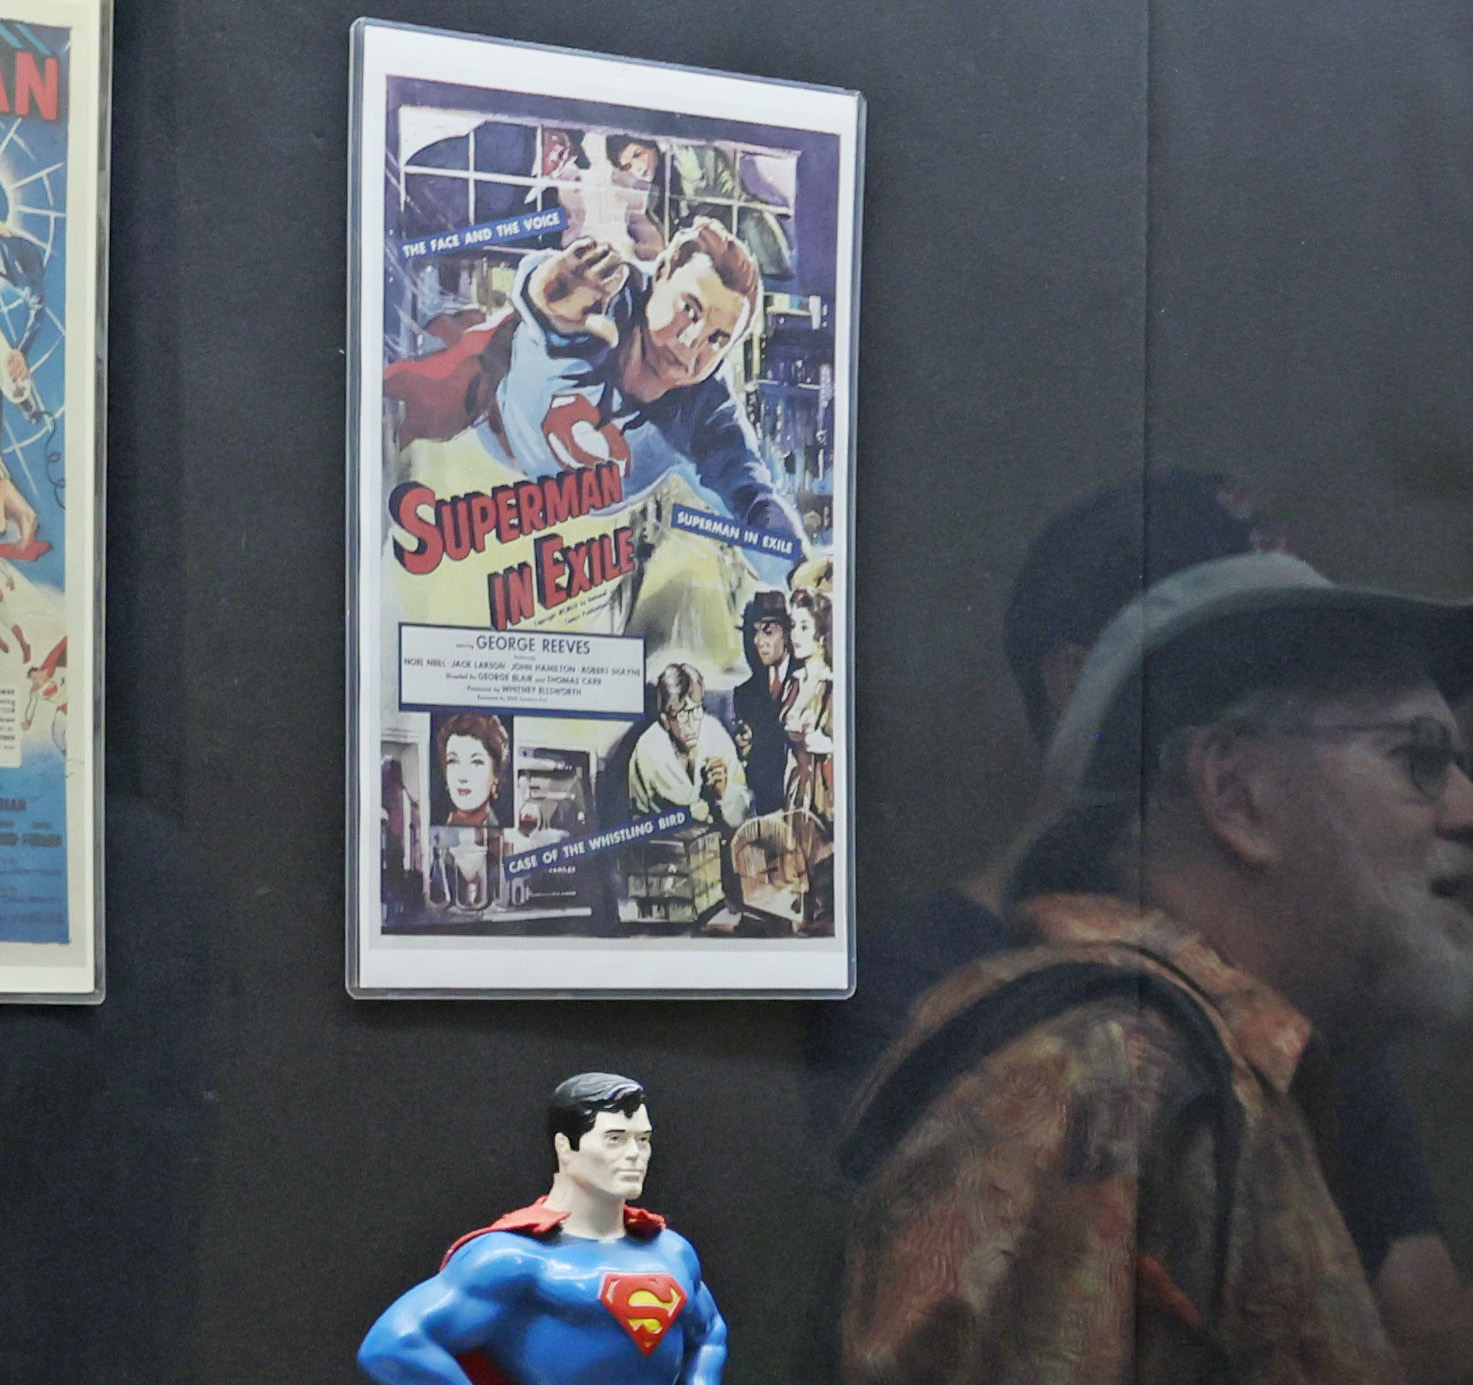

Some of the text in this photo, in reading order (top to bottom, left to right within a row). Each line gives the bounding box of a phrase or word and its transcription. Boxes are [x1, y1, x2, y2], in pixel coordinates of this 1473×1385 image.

[403, 212, 560, 258] THE FACE AND THE VOICE
[389, 461, 622, 575] SUPERMAN
[677, 511, 793, 554] SUPERMAN IN EXILE
[488, 562, 535, 631] IN
[534, 527, 635, 609] EXILE
[451, 660, 471, 668] JACK
[476, 635, 535, 652] GEORGE
[542, 638, 591, 655] REEVES
[508, 856, 538, 874] CASE
[542, 851, 558, 865] OF
[563, 841, 585, 858] THE
[588, 821, 654, 850] WHISTLING
[658, 812, 686, 831] BIRD
